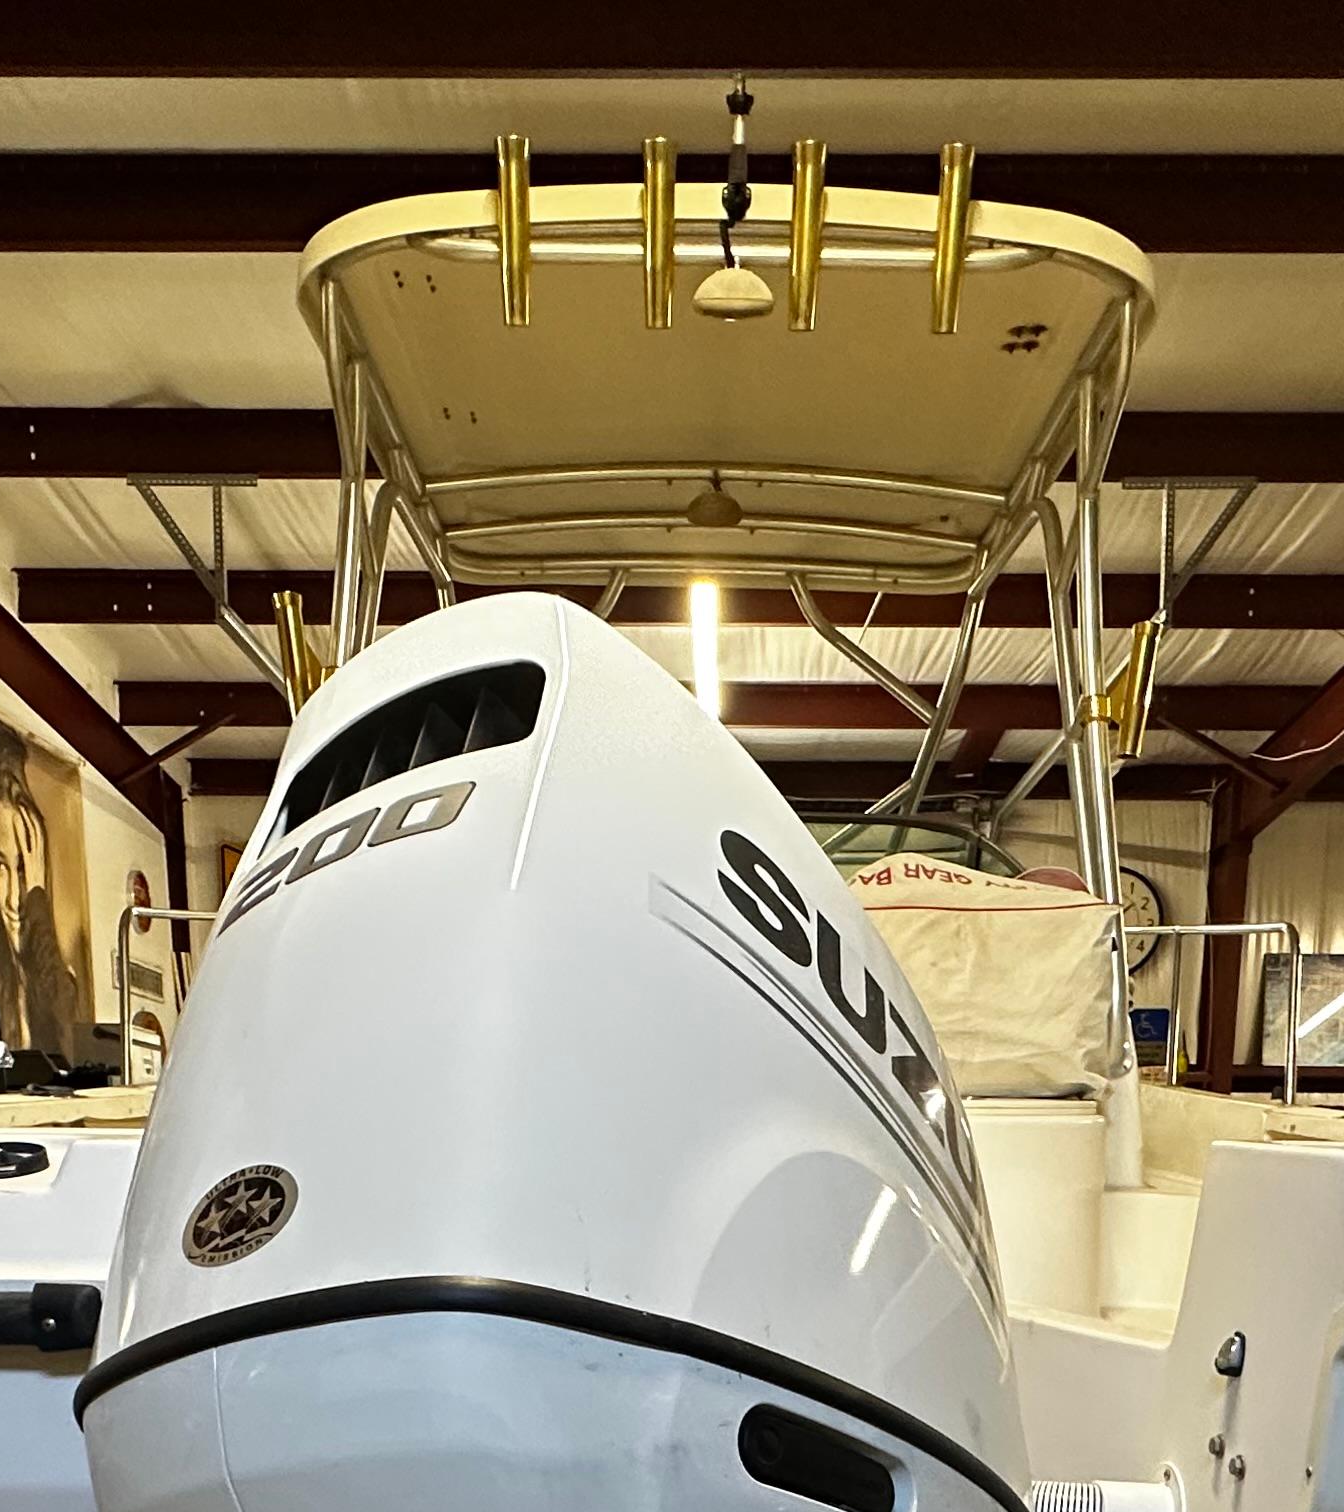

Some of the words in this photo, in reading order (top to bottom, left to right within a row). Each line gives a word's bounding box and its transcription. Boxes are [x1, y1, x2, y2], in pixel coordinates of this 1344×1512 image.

[217, 780, 477, 938] 200
[903, 862, 974, 886] GEAR
[1141, 896, 1150, 911] 2
[1136, 939, 1146, 952] 4
[255, 1164, 284, 1179] LOW
